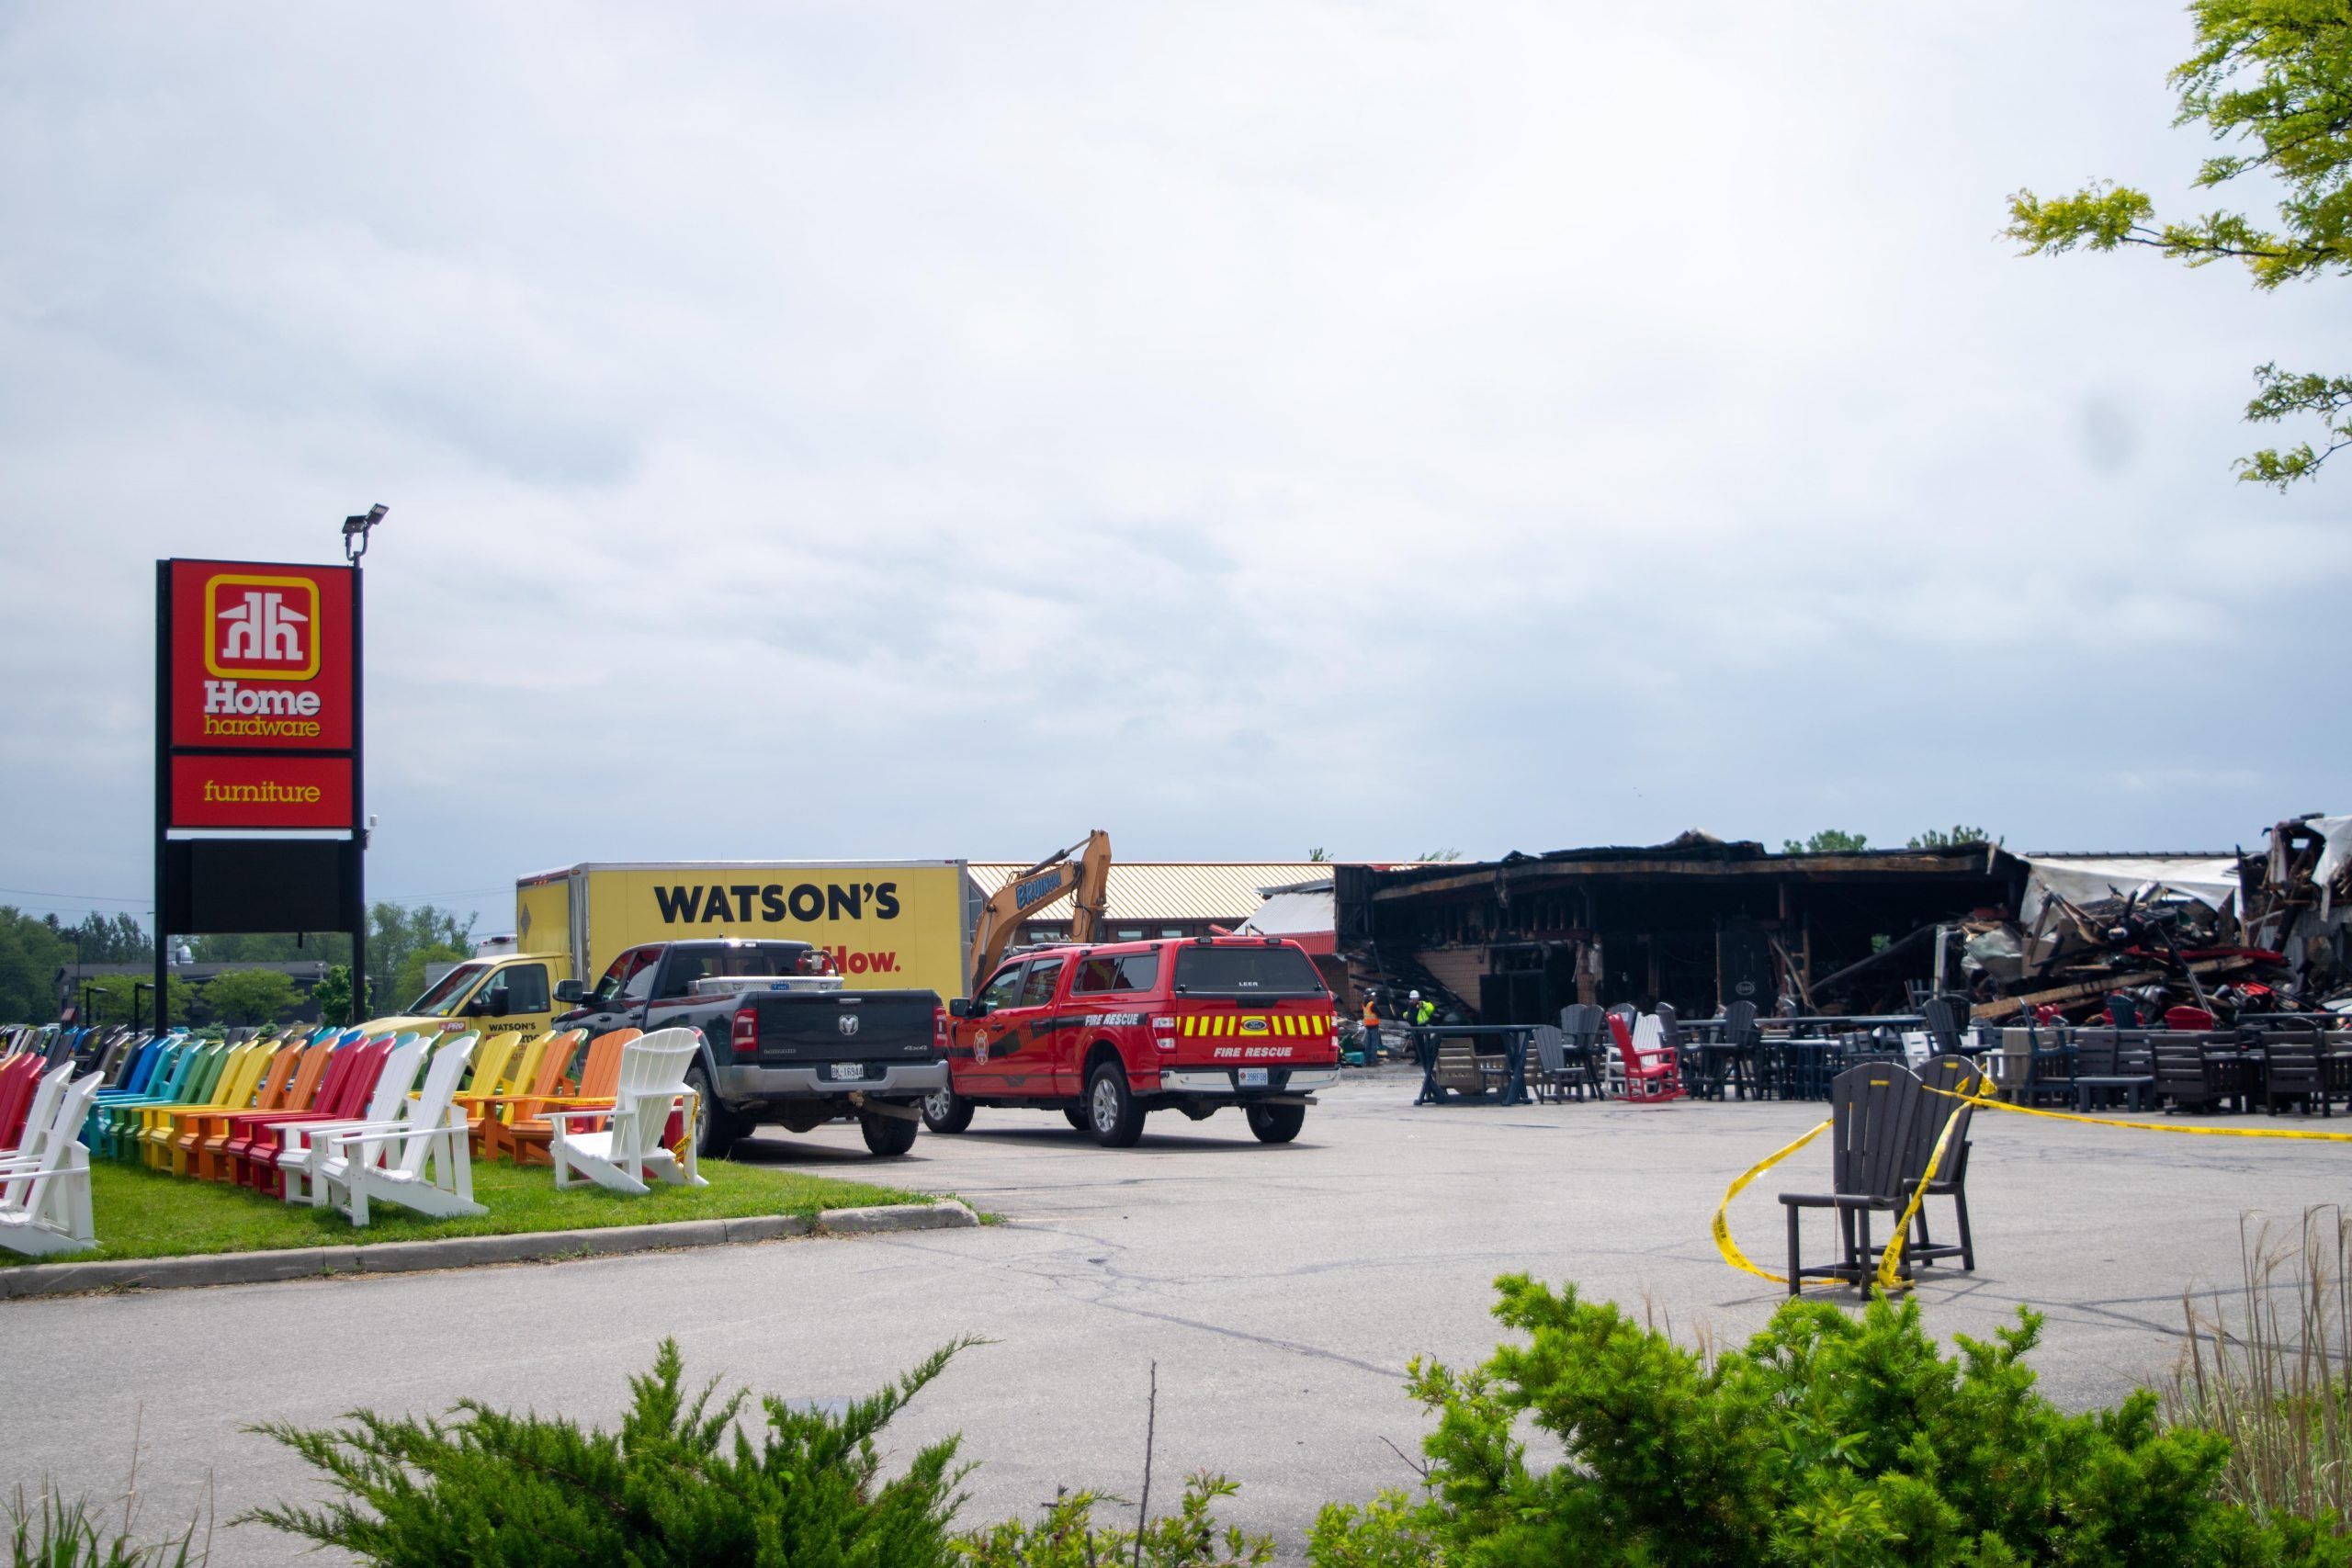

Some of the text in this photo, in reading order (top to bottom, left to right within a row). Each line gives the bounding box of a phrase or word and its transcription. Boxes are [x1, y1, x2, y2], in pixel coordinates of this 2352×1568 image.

[204, 681, 321, 716] Home
[204, 715, 321, 738] hardware
[204, 780, 321, 804] furniture
[653, 882, 900, 924] WATSON'S
[489, 1021, 537, 1032] WATSON'S
[1084, 1013, 1139, 1027] FIRE RESCUE
[1214, 1046, 1293, 1057] FIRE RESCUE
